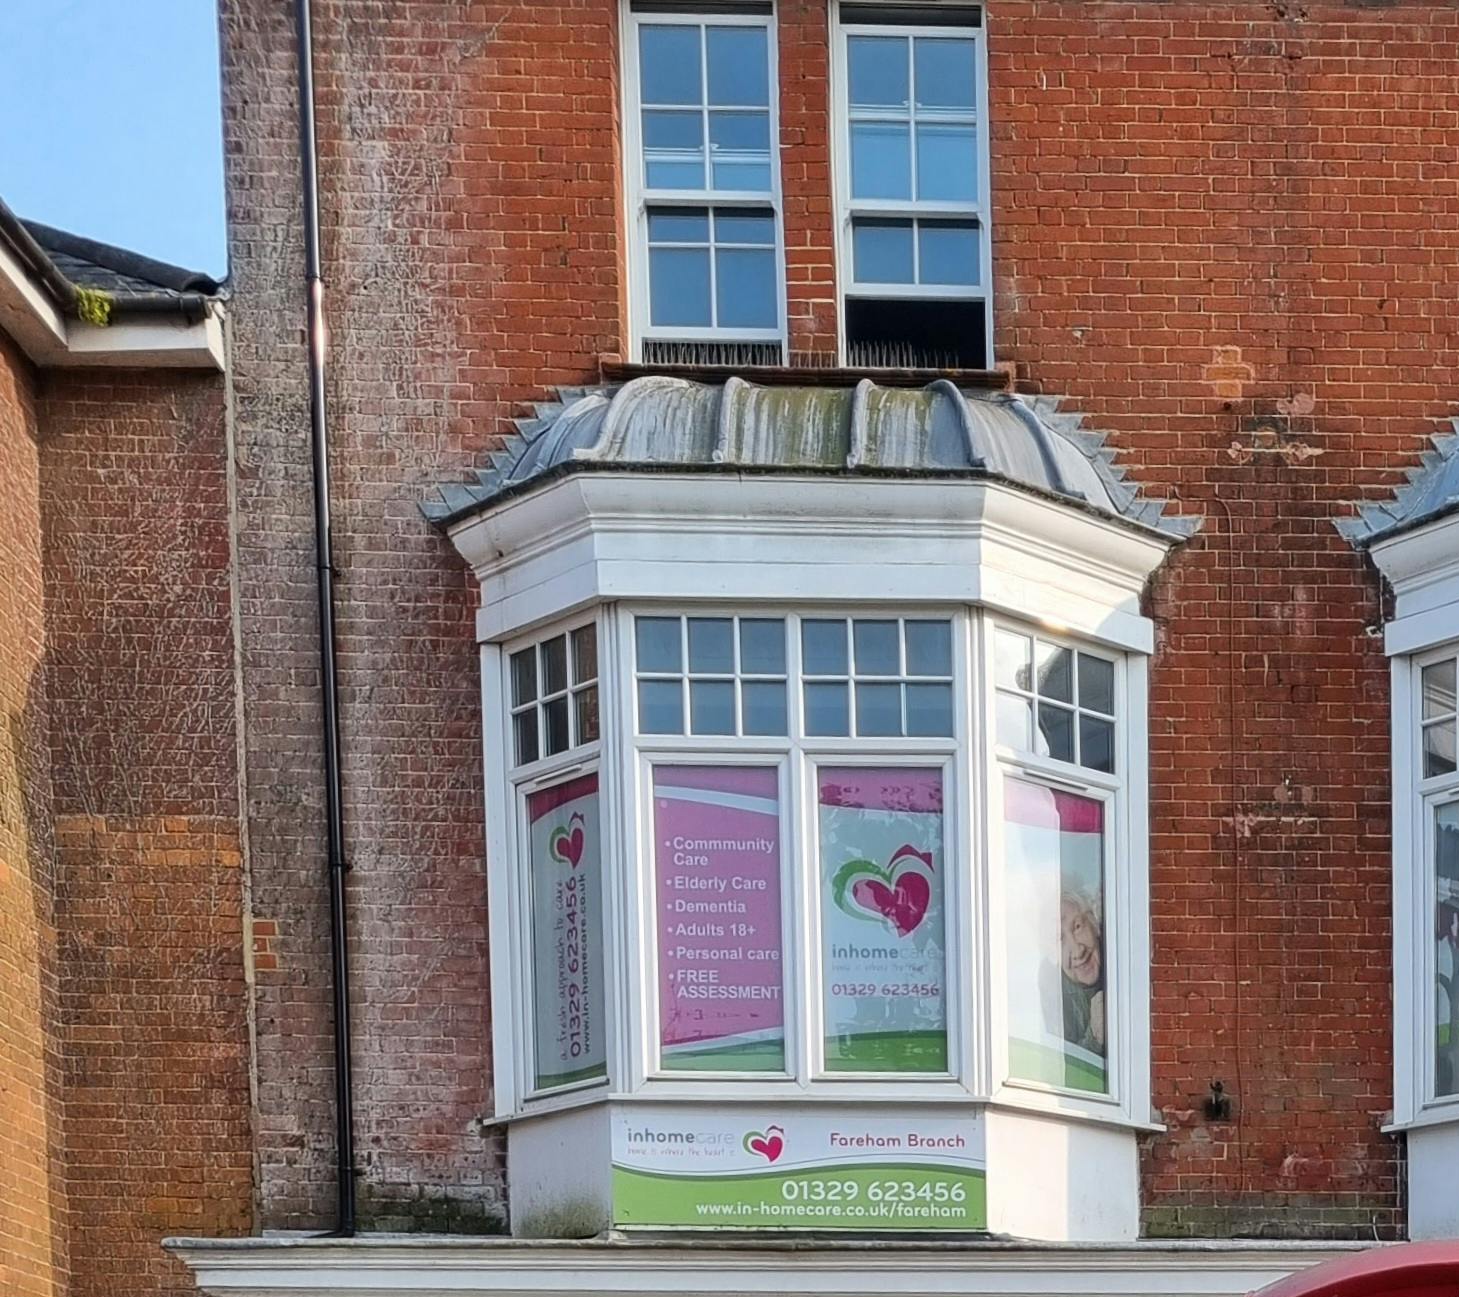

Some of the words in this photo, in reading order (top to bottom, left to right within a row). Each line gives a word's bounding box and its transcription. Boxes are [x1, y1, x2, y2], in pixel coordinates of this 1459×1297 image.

[673, 837, 775, 853] Commmunity
[673, 853, 708, 866] Care
[674, 876, 727, 893] Elderly
[732, 877, 766, 890] Care
[675, 900, 746, 913] Dementia
[565, 876, 579, 974] 623456
[675, 924, 724, 936] Adults
[730, 924, 756, 936] 18+
[676, 947, 742, 960] Personal
[747, 950, 779, 960] care
[677, 970, 719, 982] FREE
[677, 986, 781, 999] ASSESSMENT
[832, 983, 876, 996] 01329
[881, 983, 939, 996] 623456
[568, 982, 582, 1058] 01329
[628, 1128, 735, 1144] inhomecare
[830, 1133, 900, 1147] Fareham
[908, 1134, 965, 1147] Branch
[782, 1181, 858, 1200] 01329
[868, 1182, 966, 1201] 623456
[696, 1202, 966, 1218] www.in-homecare.co.uk/fareham
